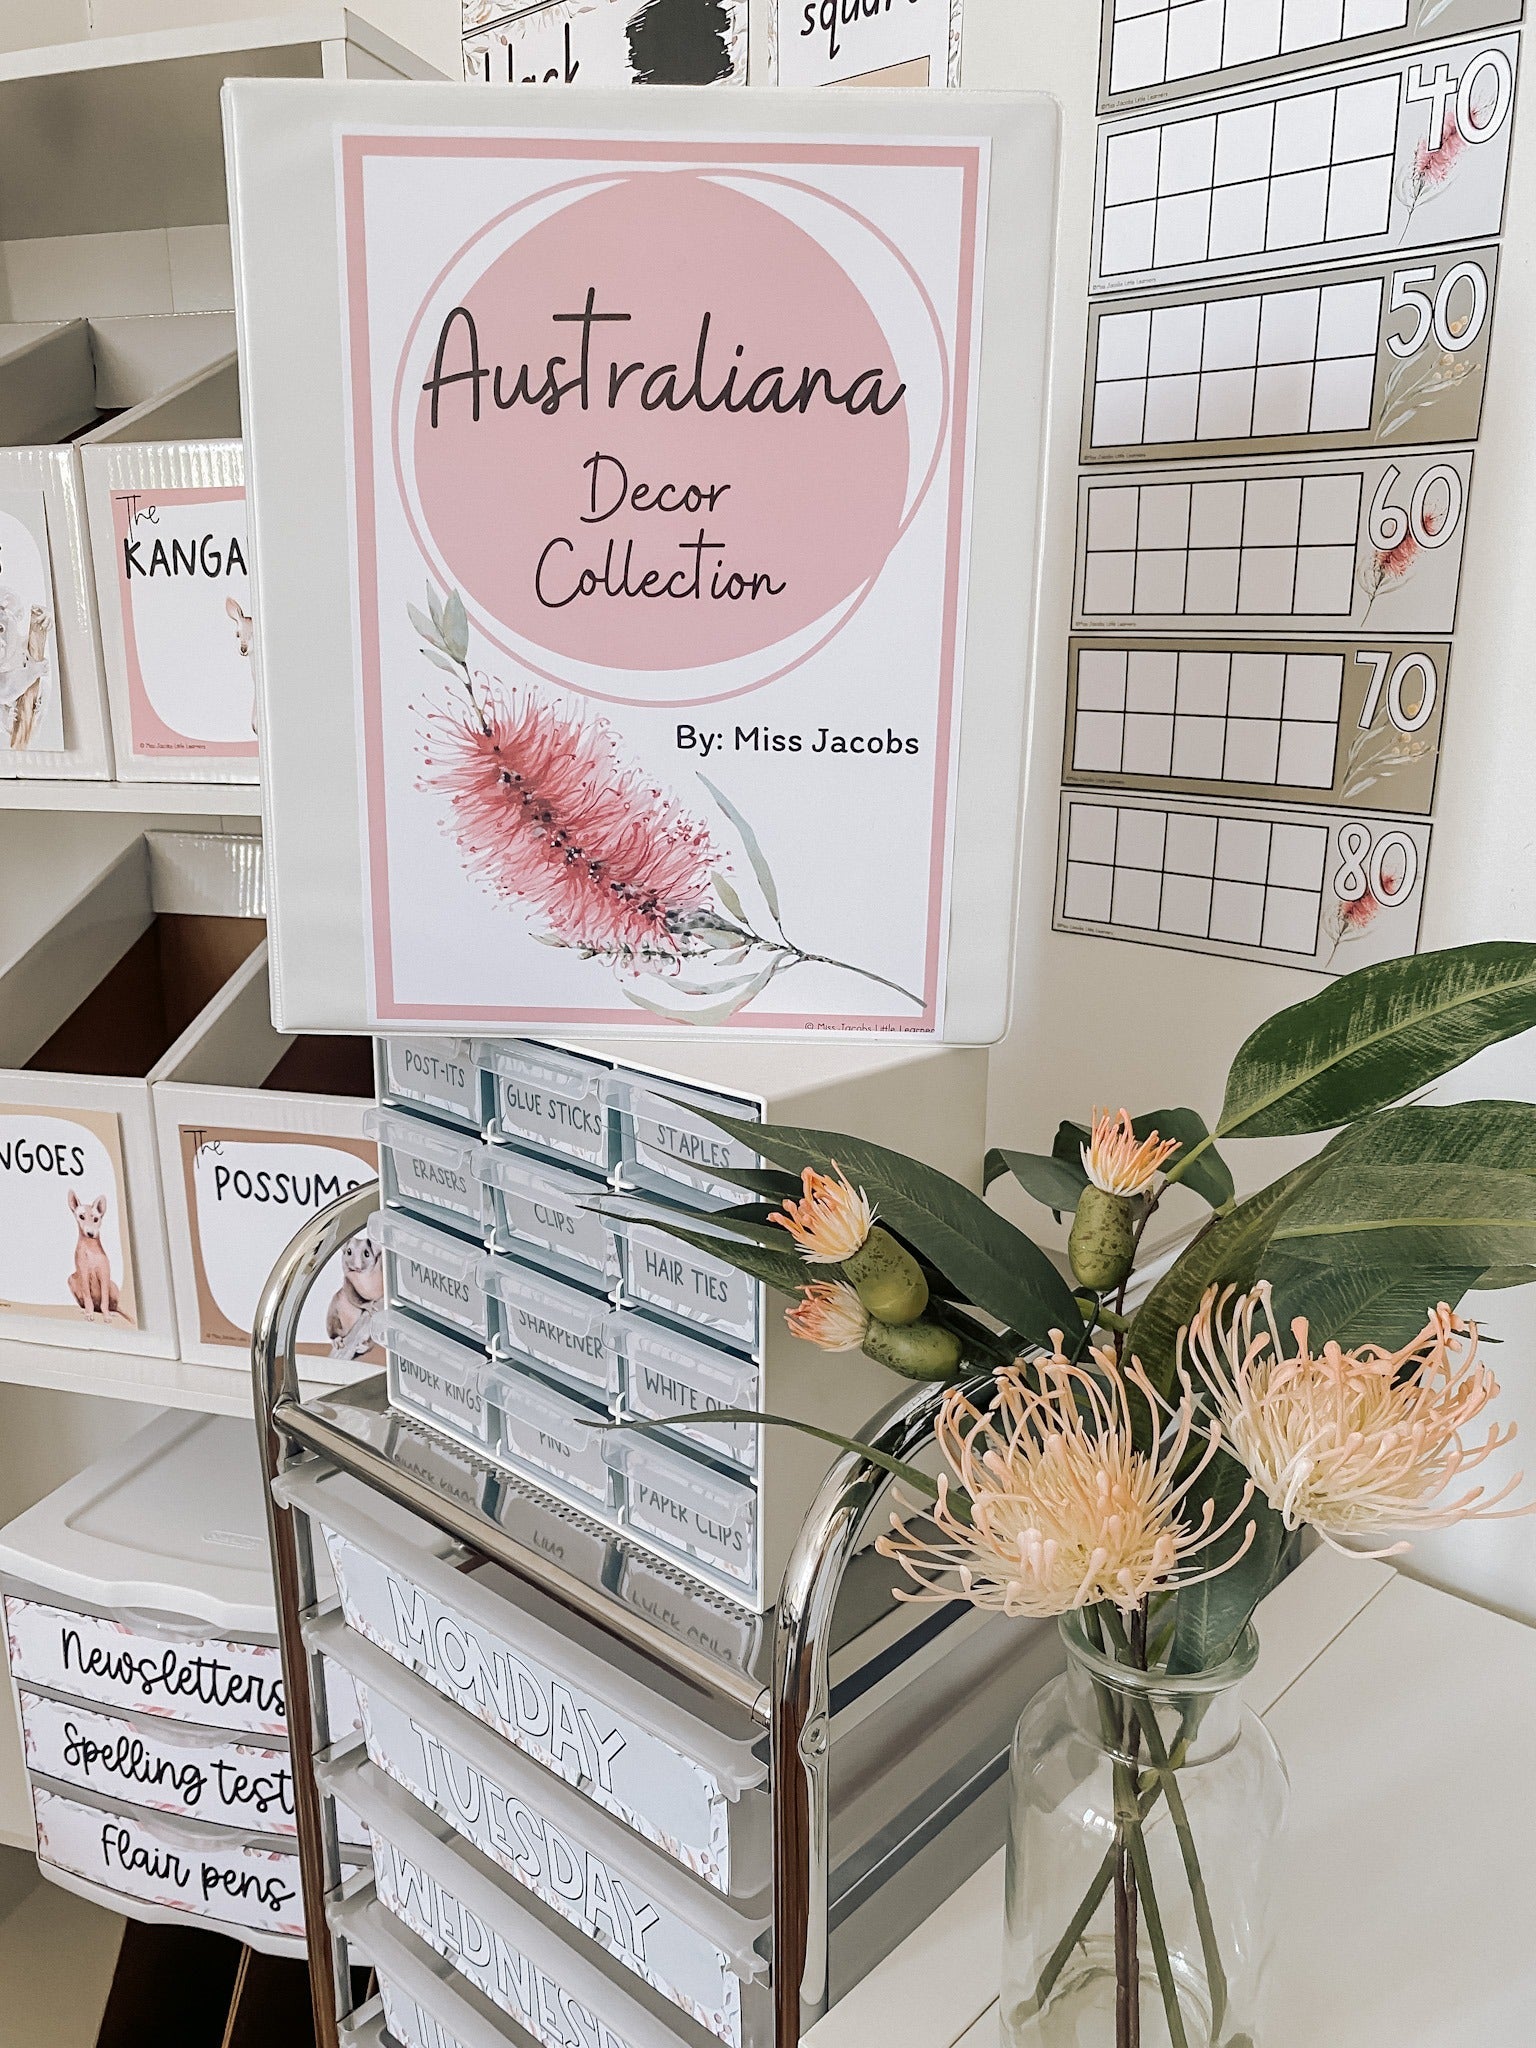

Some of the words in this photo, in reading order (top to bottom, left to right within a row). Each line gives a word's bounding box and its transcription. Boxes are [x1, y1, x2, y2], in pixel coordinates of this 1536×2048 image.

[1405, 48, 1513, 152] 40
[1386, 261, 1489, 358] 50
[422, 287, 907, 429] Australiana
[580, 451, 731, 524] Decor
[1368, 464, 1463, 551] 60
[115, 494, 160, 543] The
[123, 533, 248, 579] KANGA
[535, 528, 787, 609] Collection
[1353, 649, 1438, 733] 70
[676, 724, 723, 758] By:
[734, 726, 803, 752] Miss
[811, 728, 920, 755] Jacobs
[1332, 822, 1419, 908] 80
[405, 1049, 465, 1089] POST-ITS
[506, 1083, 542, 1116] GLUE
[547, 1099, 602, 1136] STICKS
[183, 1130, 225, 1169] The
[657, 1124, 730, 1169] STAPLES
[412, 1158, 467, 1194] ERASERS
[534, 1203, 575, 1236] CLIPS
[410, 1260, 470, 1303] MARKERS
[645, 1249, 684, 1286] HAIR
[690, 1268, 729, 1303] TIES
[644, 1367, 698, 1412] WHITE
[695, 1513, 743, 1552] CLIPS
[62, 1628, 286, 1717] Newsletters
[386, 1576, 627, 1794] MONDAY
[64, 1721, 208, 1806] Spelling
[410, 1718, 660, 1963] TUESDAY
[201, 1862, 296, 1912] pens
